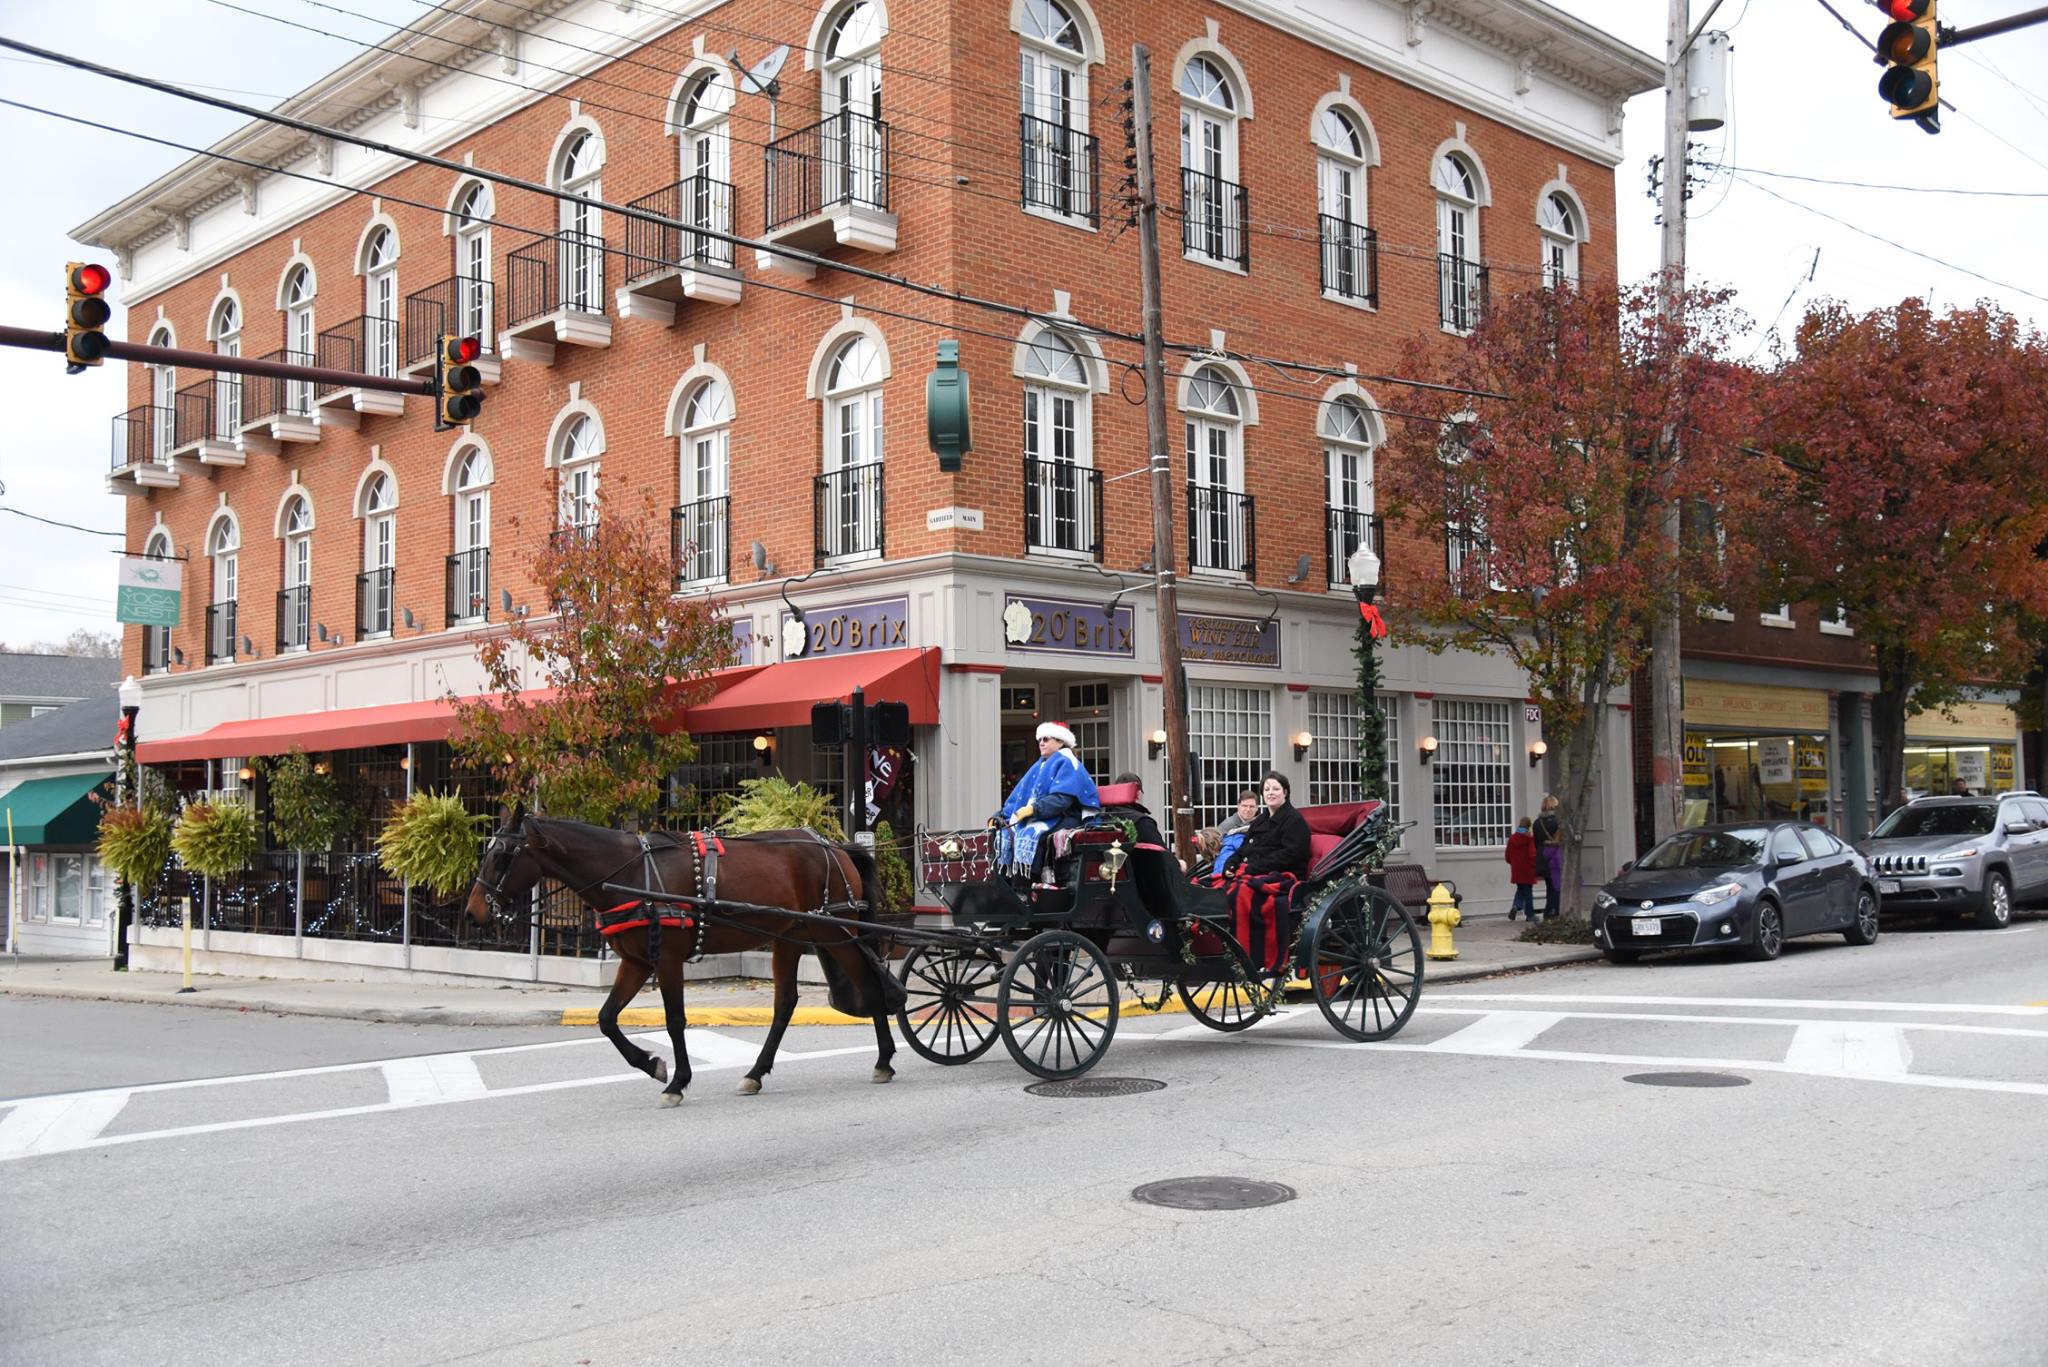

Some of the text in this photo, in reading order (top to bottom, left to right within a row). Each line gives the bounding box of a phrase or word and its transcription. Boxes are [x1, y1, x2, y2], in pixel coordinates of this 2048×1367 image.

[962, 515, 977, 523] MAIN
[121, 591, 177, 607] YOGA
[122, 605, 177, 619] NEST
[1190, 628, 1228, 647] WINE
[1526, 708, 1539, 720] FDC
